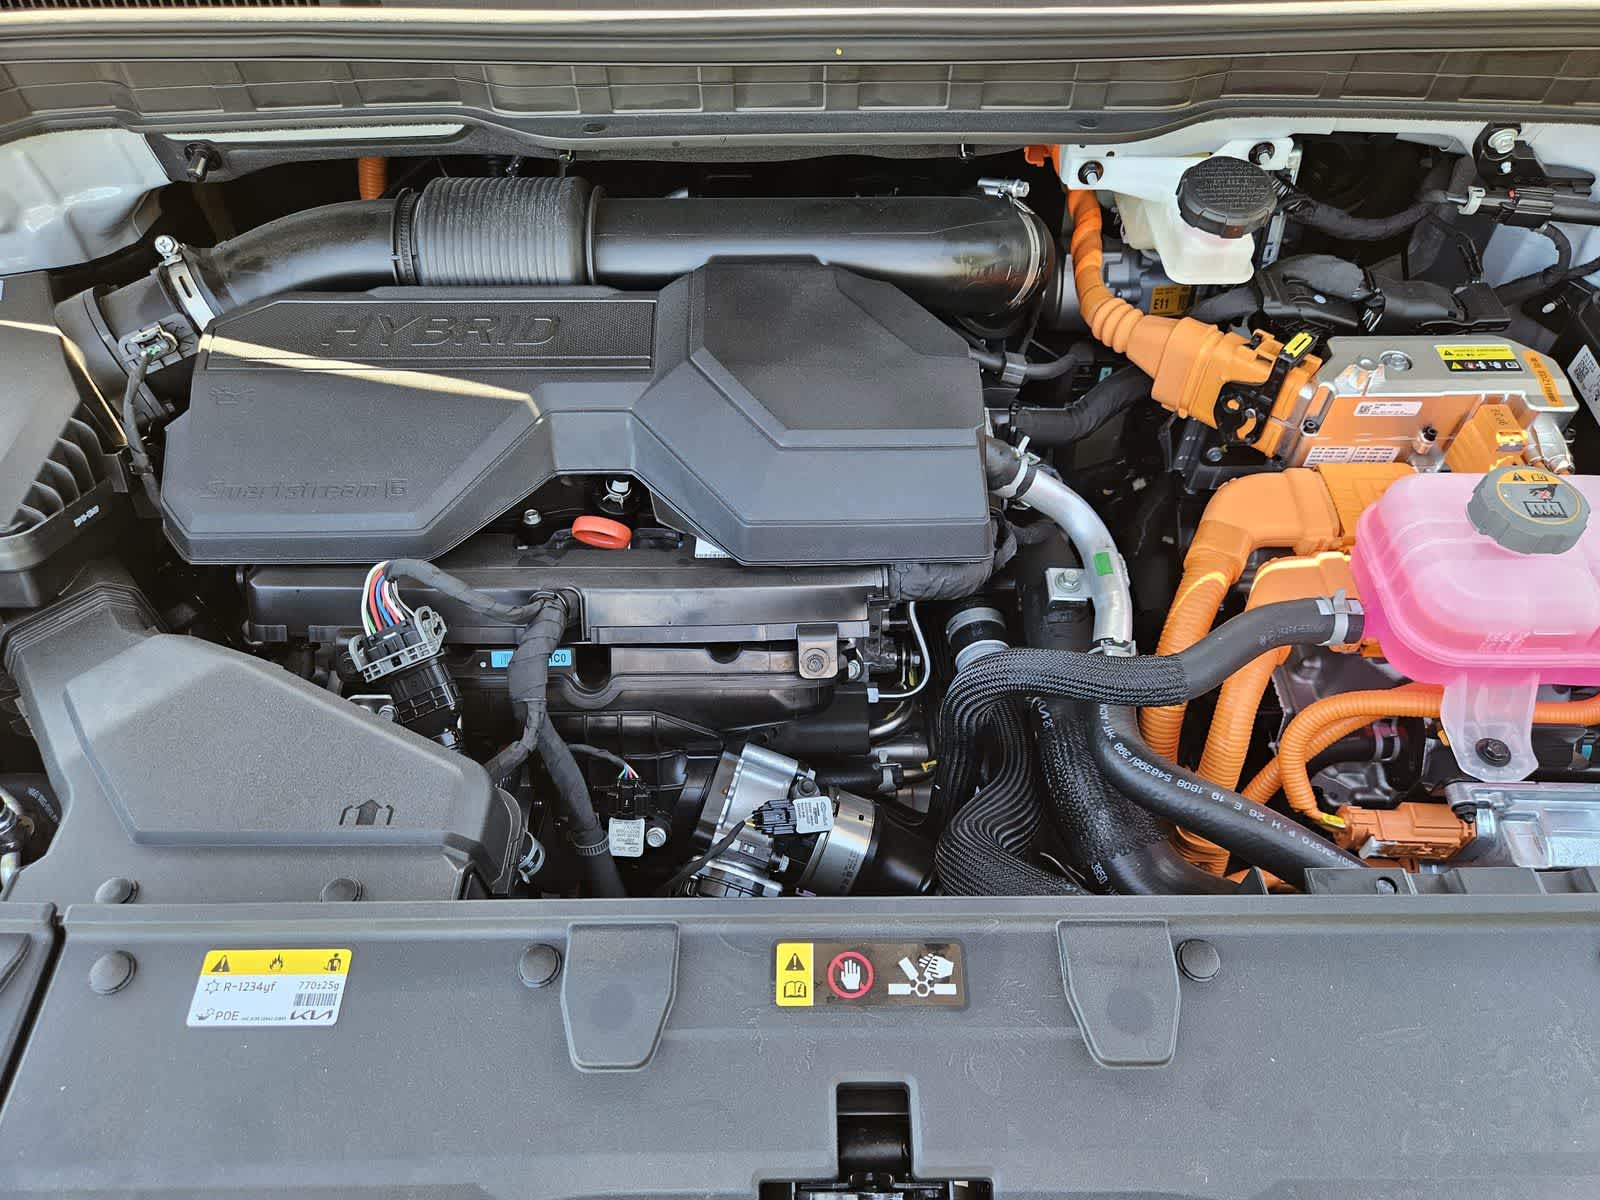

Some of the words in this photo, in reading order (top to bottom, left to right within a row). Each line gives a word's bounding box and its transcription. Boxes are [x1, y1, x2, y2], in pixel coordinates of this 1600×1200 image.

[320, 312, 561, 347] HYBRID
[223, 980, 277, 994] R-1234yf
[298, 980, 340, 992] 770±25g
[214, 1010, 241, 1021] POE
[290, 1009, 334, 1021] KIA
